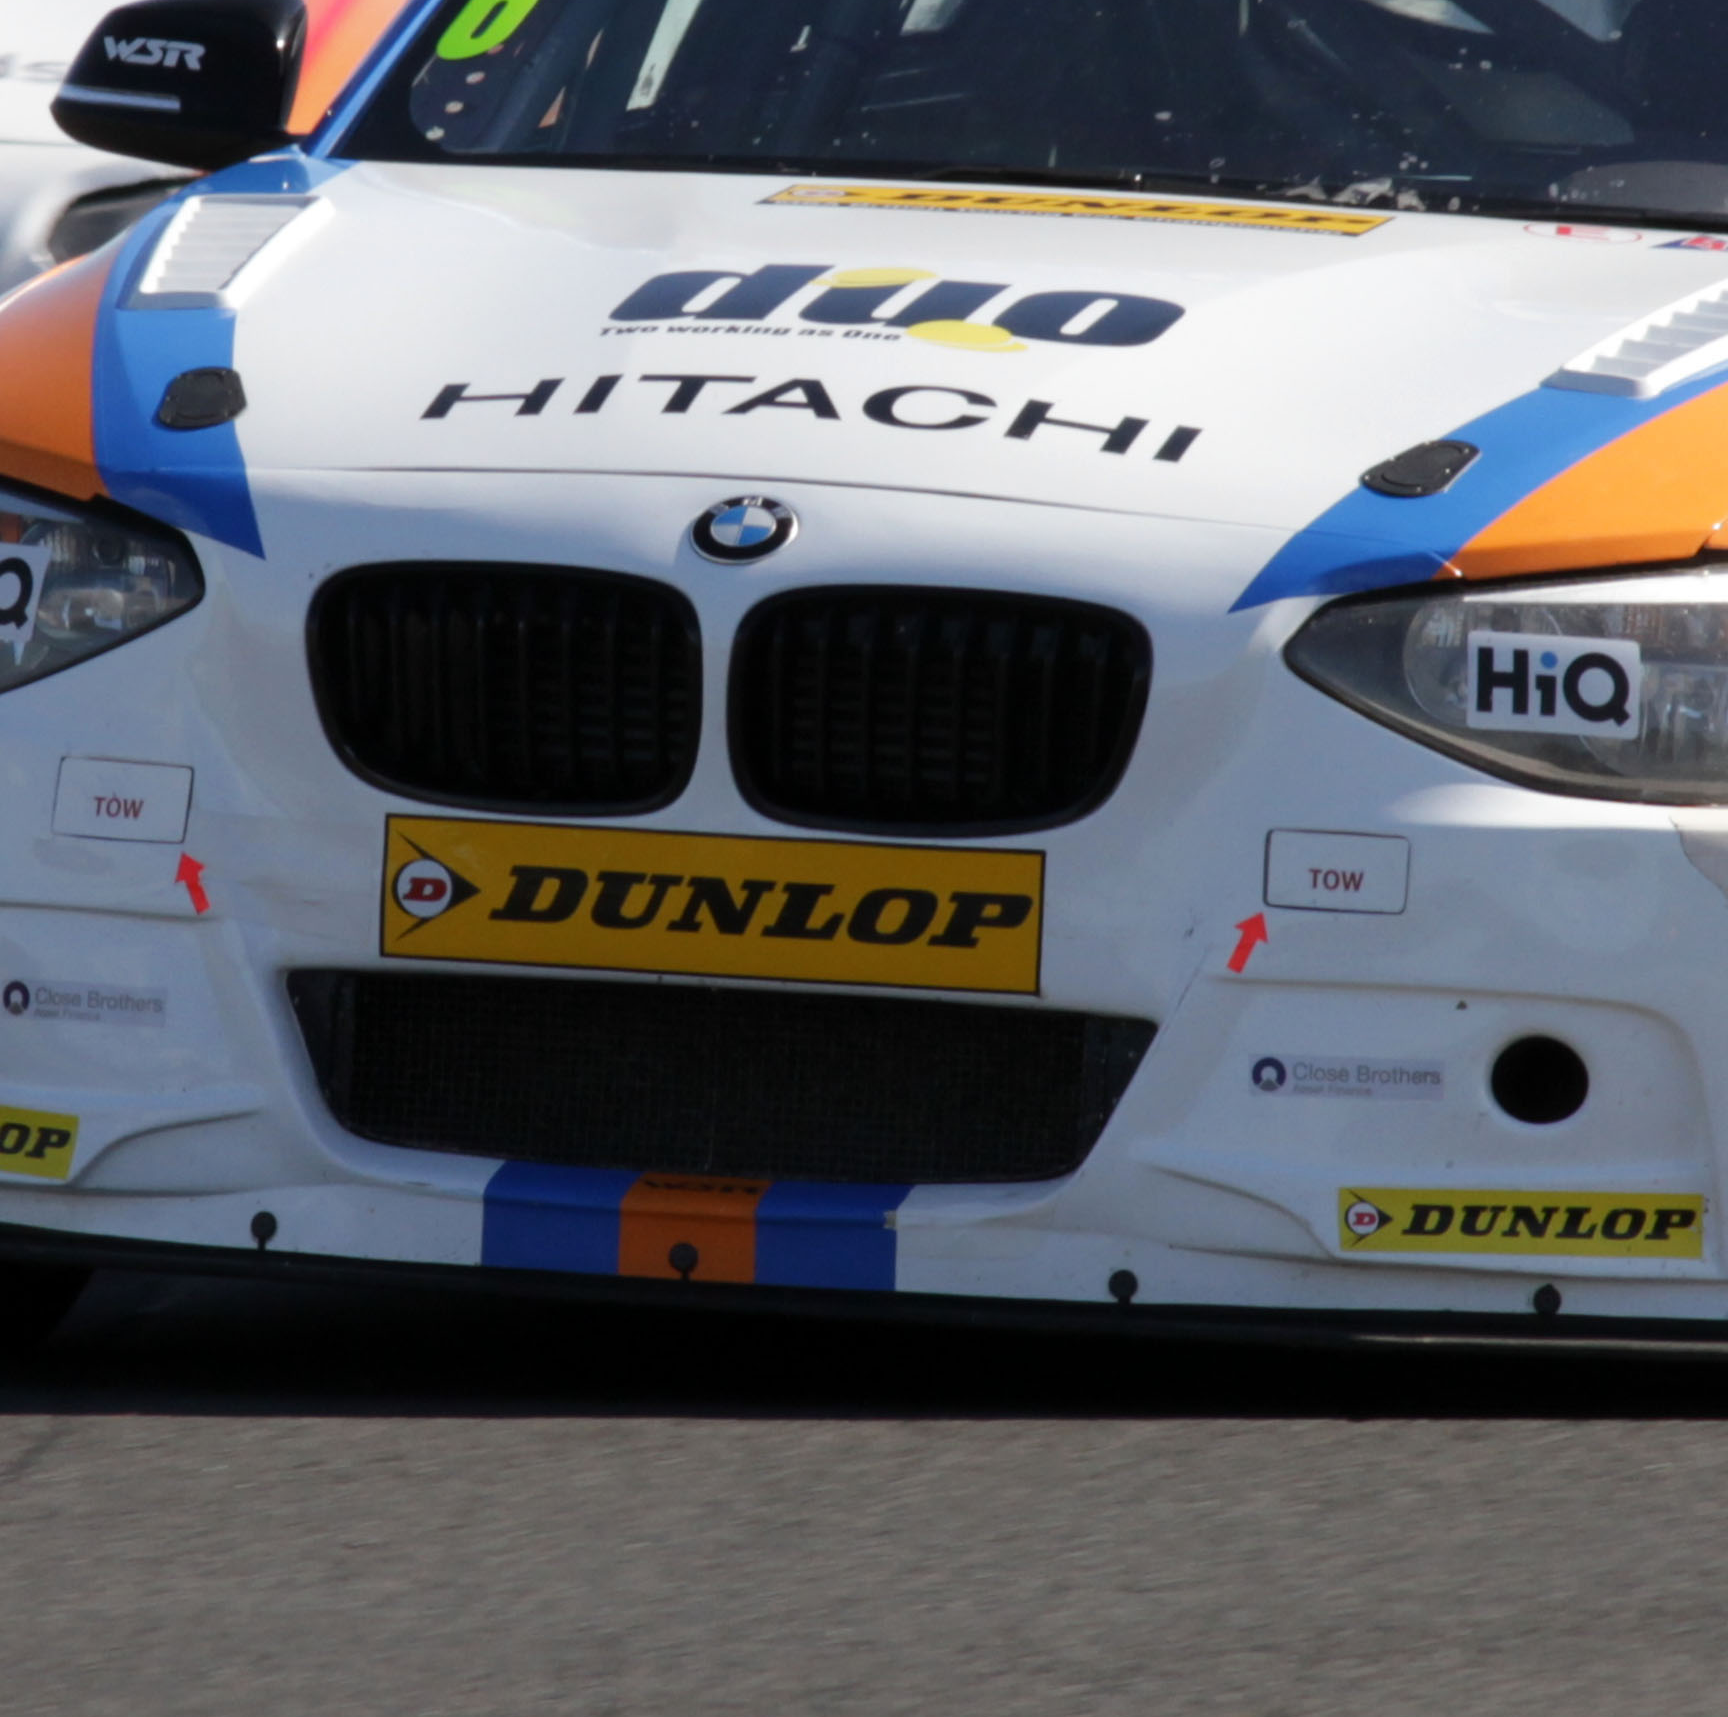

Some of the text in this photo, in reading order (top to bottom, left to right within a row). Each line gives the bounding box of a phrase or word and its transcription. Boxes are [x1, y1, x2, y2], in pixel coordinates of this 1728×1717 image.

[103, 36, 205, 70] WSR
[608, 264, 1187, 347] duo
[666, 325, 792, 337] working
[797, 328, 834, 337] as
[420, 374, 1204, 463] HITACHI
[1476, 646, 1632, 726] HiQ
[93, 794, 145, 820] TOW
[1309, 867, 1365, 892] TOW
[488, 865, 1034, 949] DUNLOP
[34, 986, 163, 1014] Close Brothers
[1292, 1061, 1442, 1086] Close Brothers
[1400, 1202, 1699, 1242] DUNLOP
